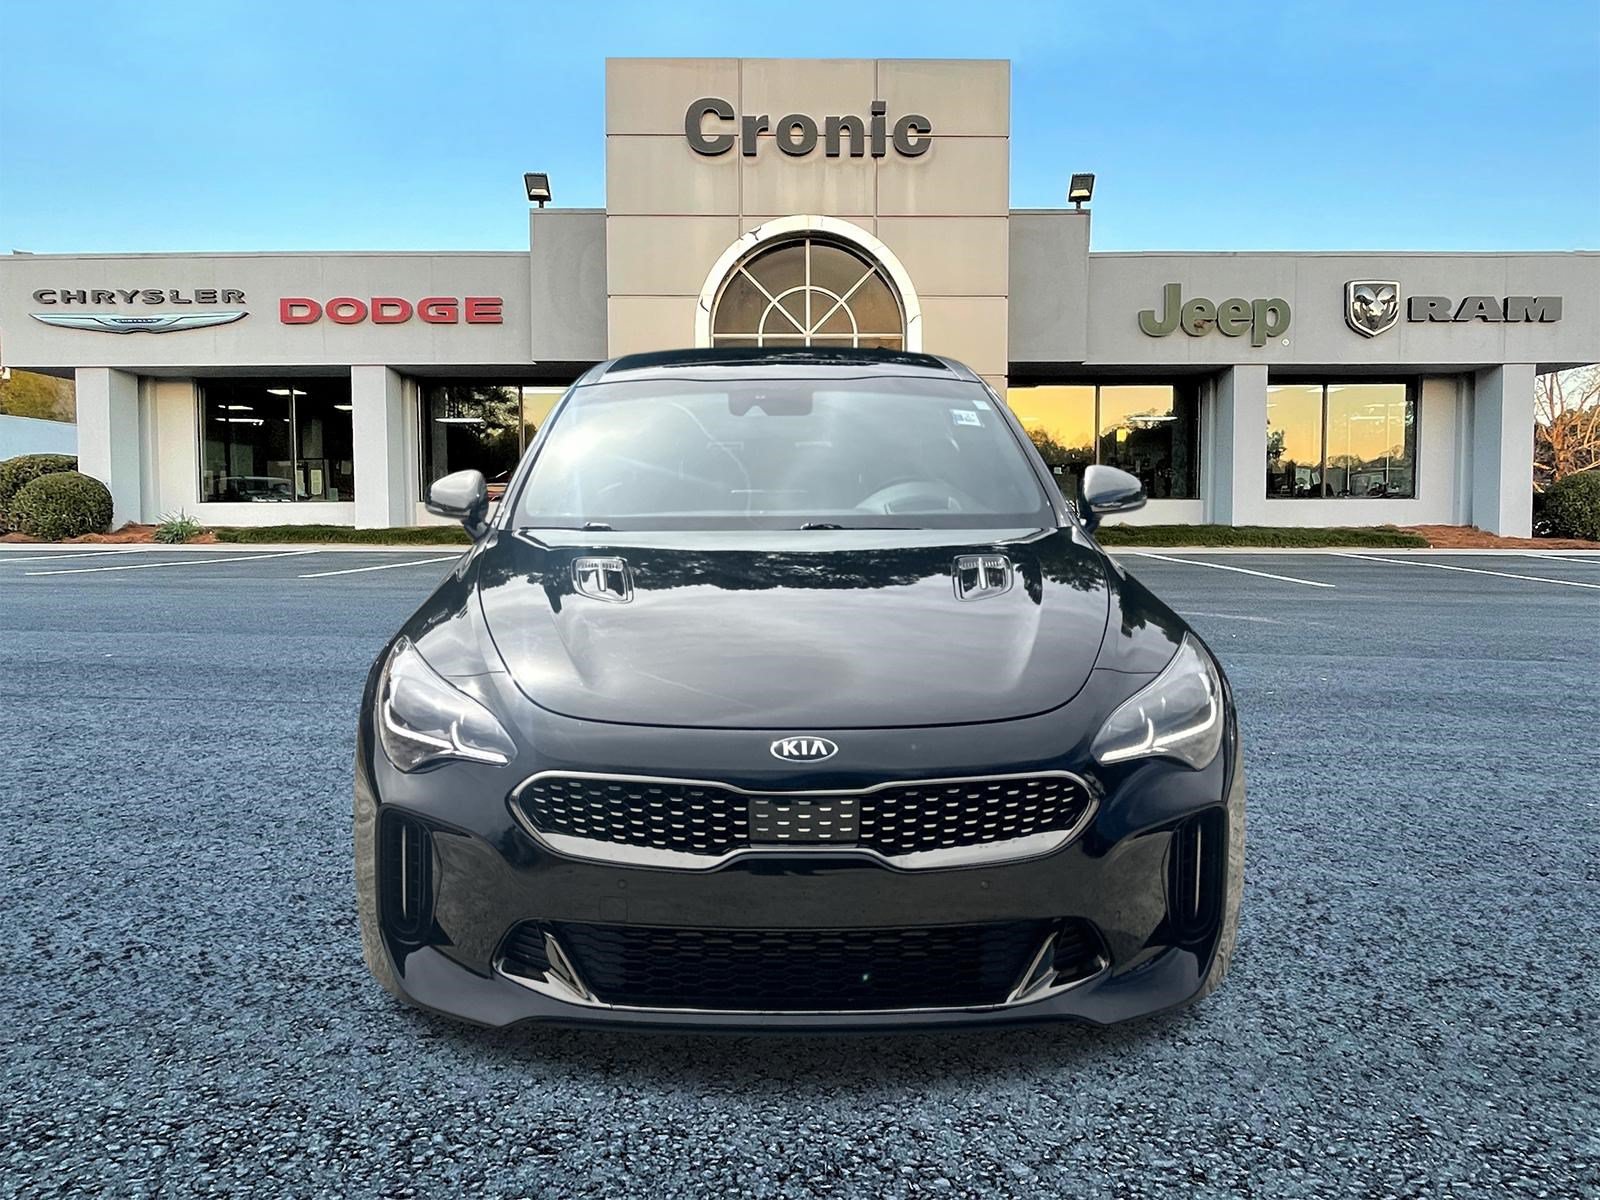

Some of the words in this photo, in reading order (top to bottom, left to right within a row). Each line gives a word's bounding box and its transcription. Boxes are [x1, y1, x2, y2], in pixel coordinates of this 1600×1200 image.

[685, 97, 932, 157] Cronic
[33, 289, 246, 304] CHRYSLER
[1408, 296, 1562, 322] RAM
[280, 297, 503, 324] DODGE
[1138, 283, 1291, 347] Jeep
[782, 740, 828, 756] KIA
